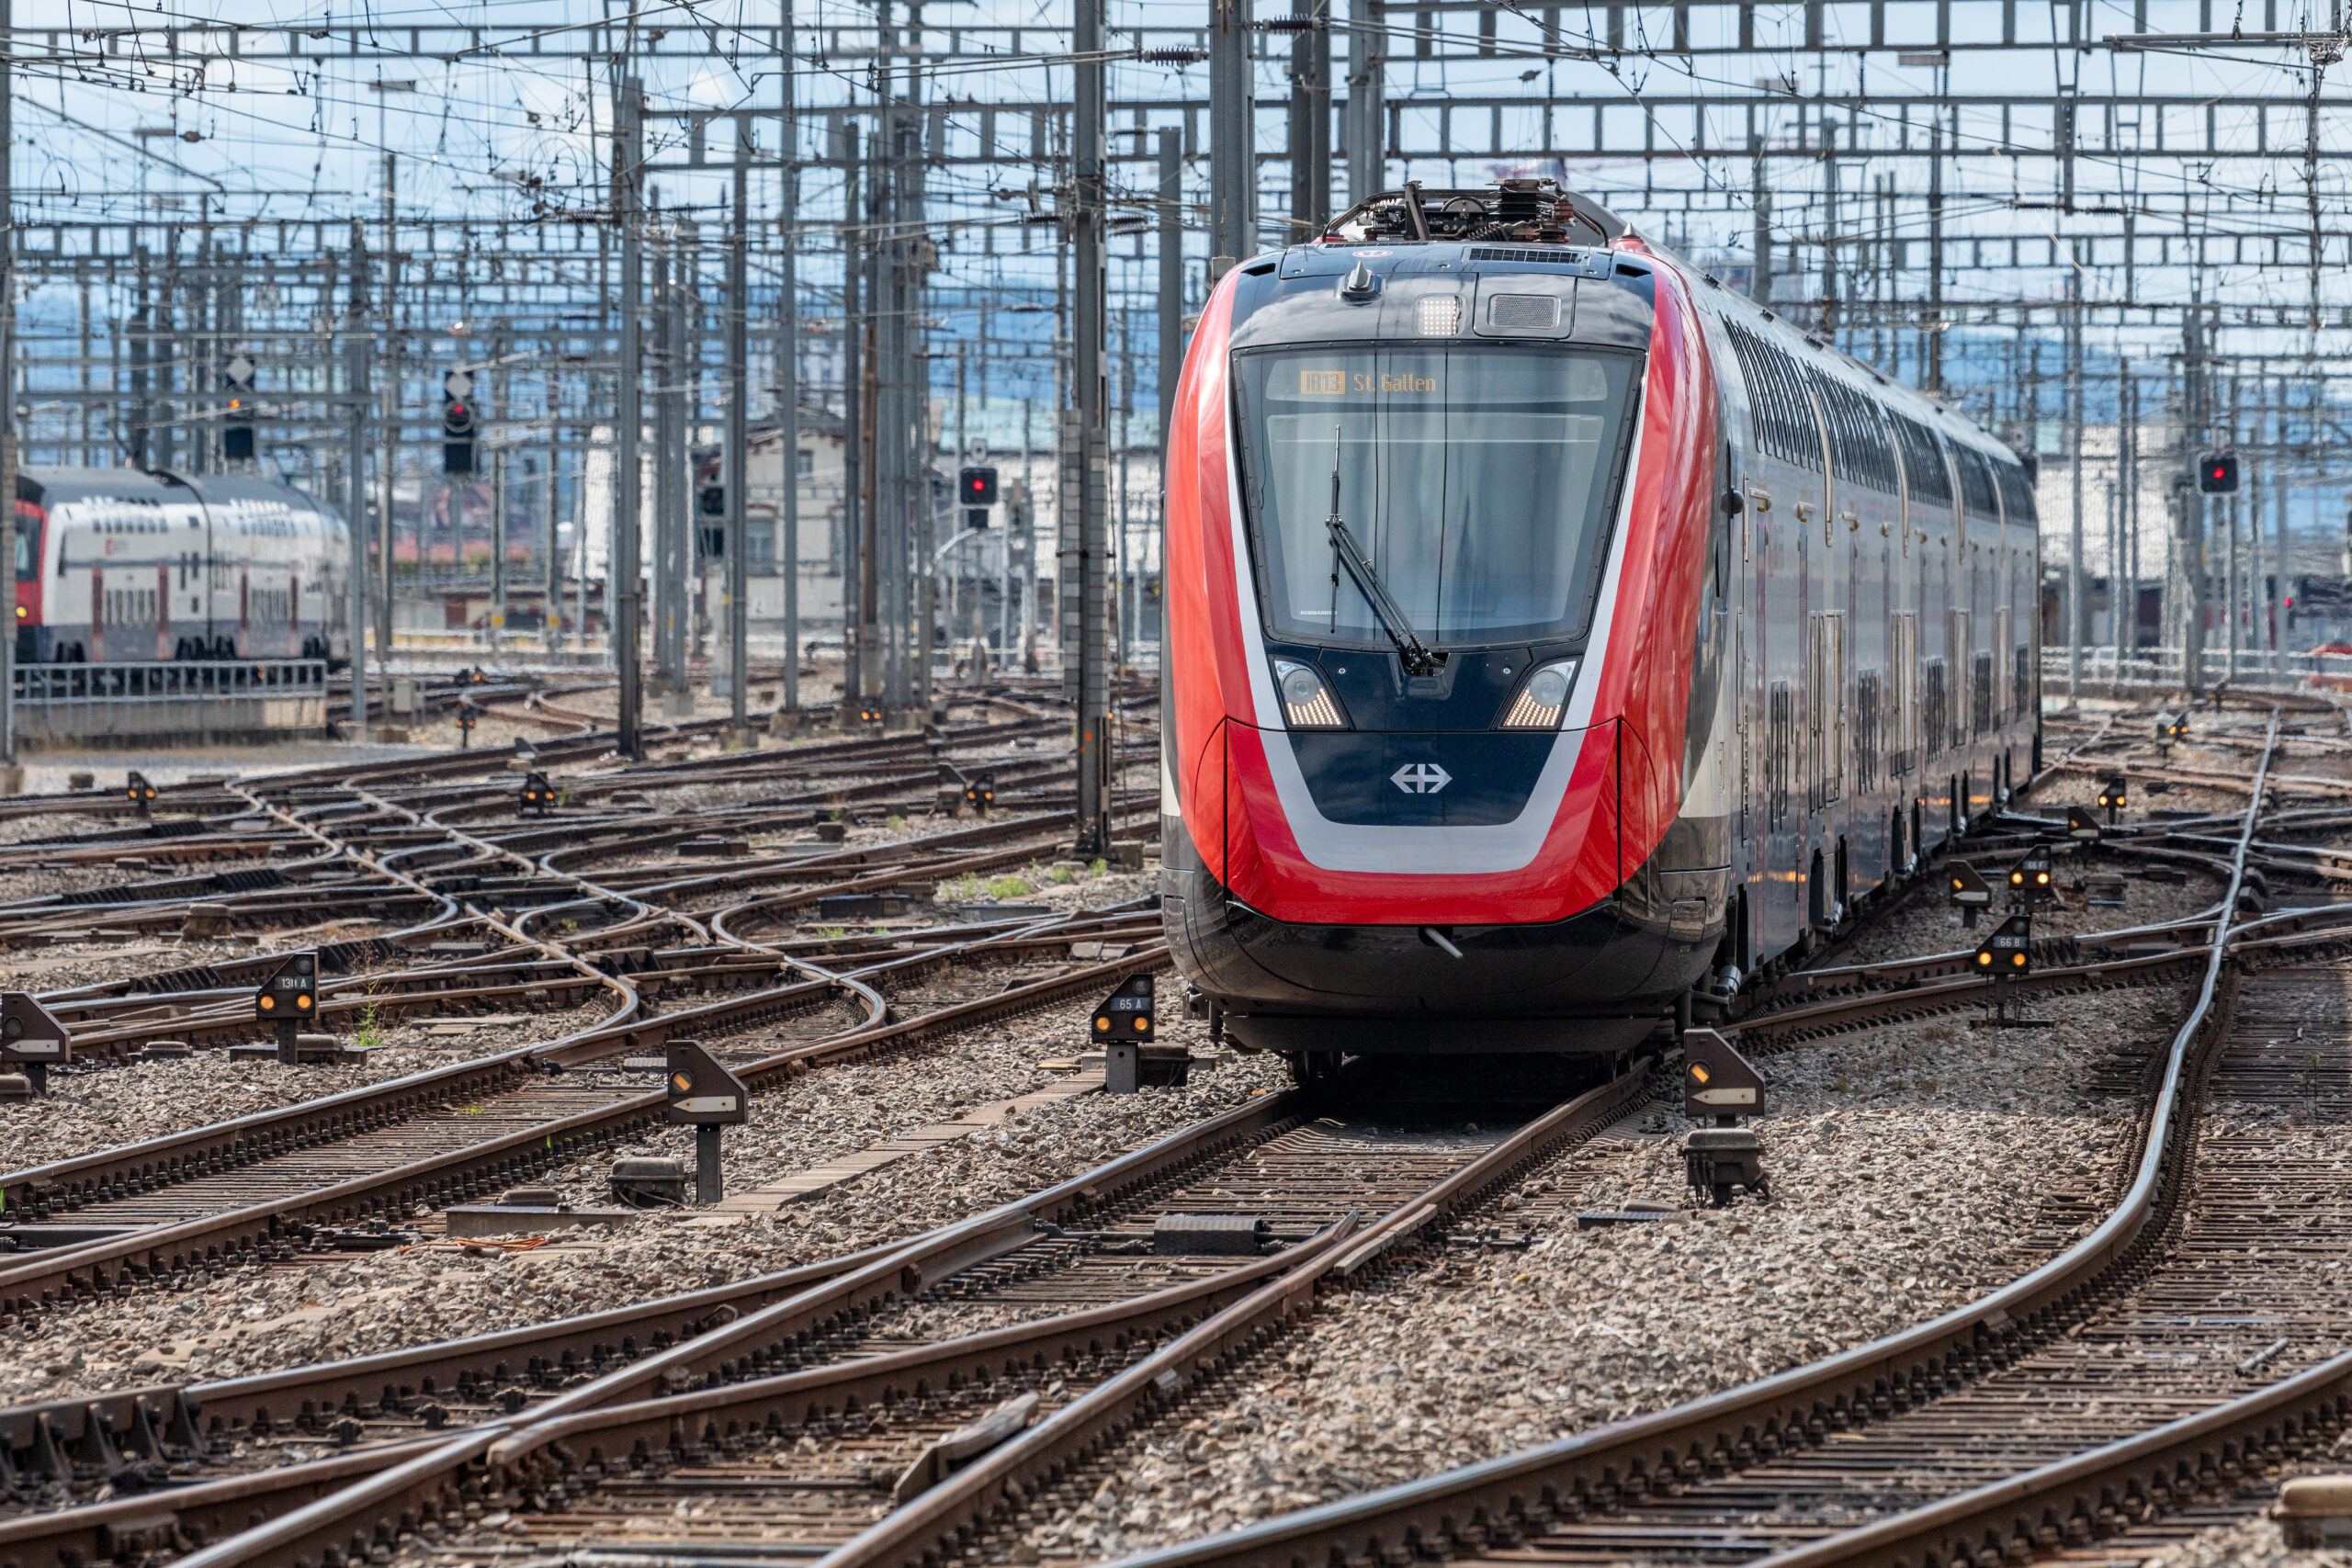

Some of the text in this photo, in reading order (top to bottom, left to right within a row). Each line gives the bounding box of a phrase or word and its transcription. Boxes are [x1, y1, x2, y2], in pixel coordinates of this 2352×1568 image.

[1305, 373, 1436, 392] IR13 St. Gallen
[2000, 937, 2012, 947] 66
[300, 977, 307, 988] A
[1119, 999, 1142, 1010] 65 A
